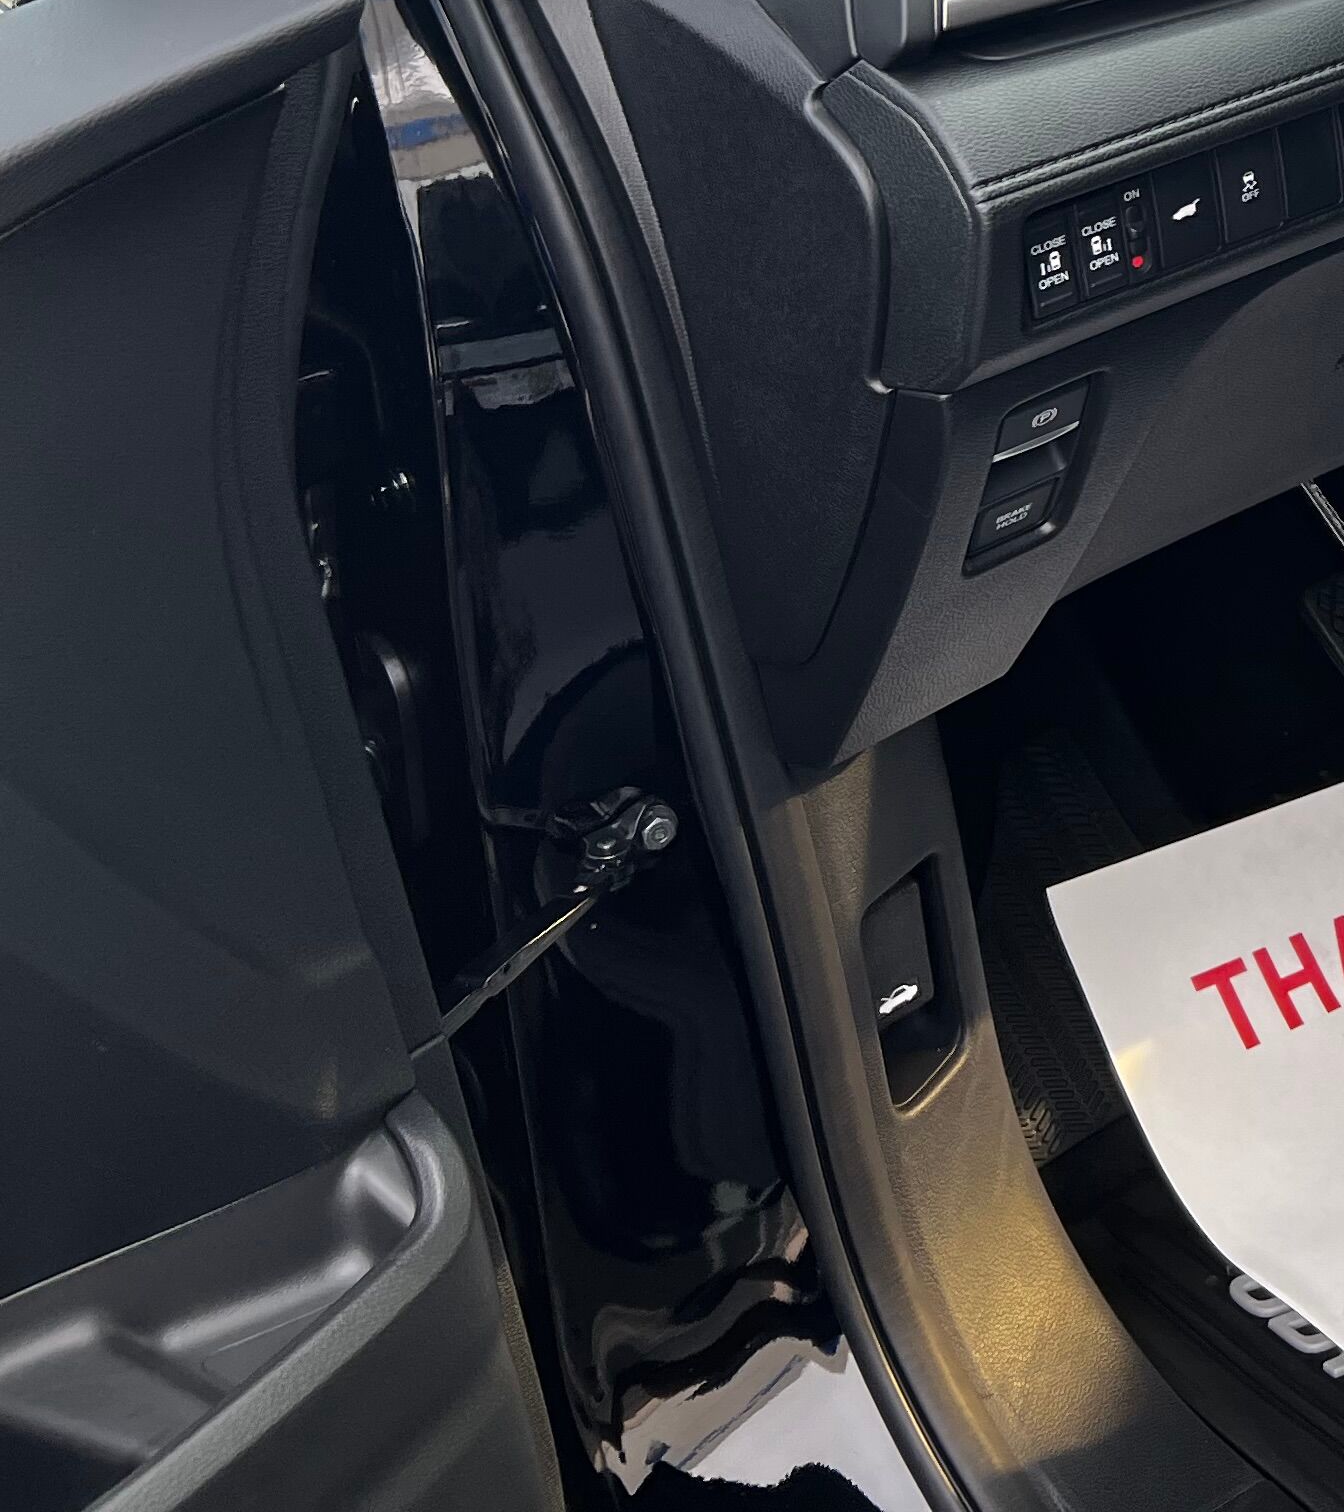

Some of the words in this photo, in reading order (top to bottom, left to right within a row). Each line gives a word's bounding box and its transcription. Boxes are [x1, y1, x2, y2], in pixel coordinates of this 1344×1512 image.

[1123, 188, 1141, 202] ON
[1241, 189, 1260, 203] OFF
[1080, 216, 1117, 237] CLOSE
[1030, 234, 1067, 256] CLOSE
[1089, 252, 1120, 272] OPEN
[1038, 270, 1070, 290] OPEN
[995, 502, 1033, 524] BRAKE
[996, 511, 1028, 530] HOLD
